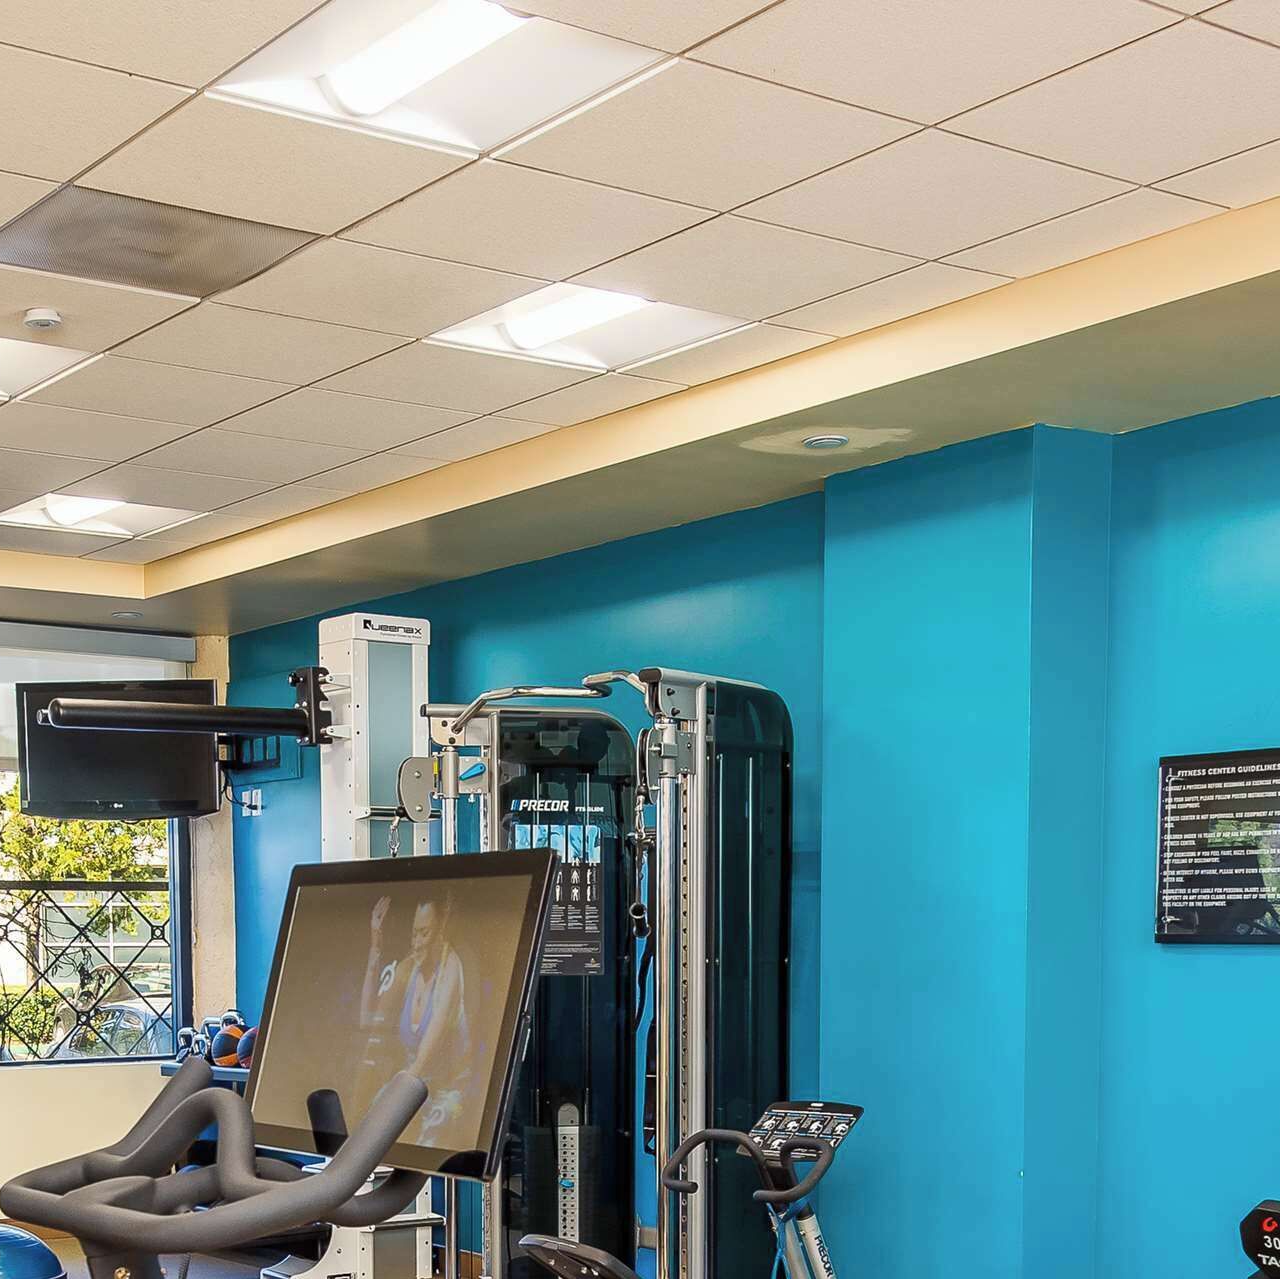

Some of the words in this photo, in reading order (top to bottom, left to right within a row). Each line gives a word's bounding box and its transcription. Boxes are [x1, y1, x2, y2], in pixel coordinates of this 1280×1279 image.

[1178, 769, 1206, 777] FITNESS
[1208, 766, 1236, 775] CENTER
[519, 800, 569, 812] PRECOR
[1264, 1236, 1280, 1250] 30
[814, 1235, 834, 1278] PRECOR
